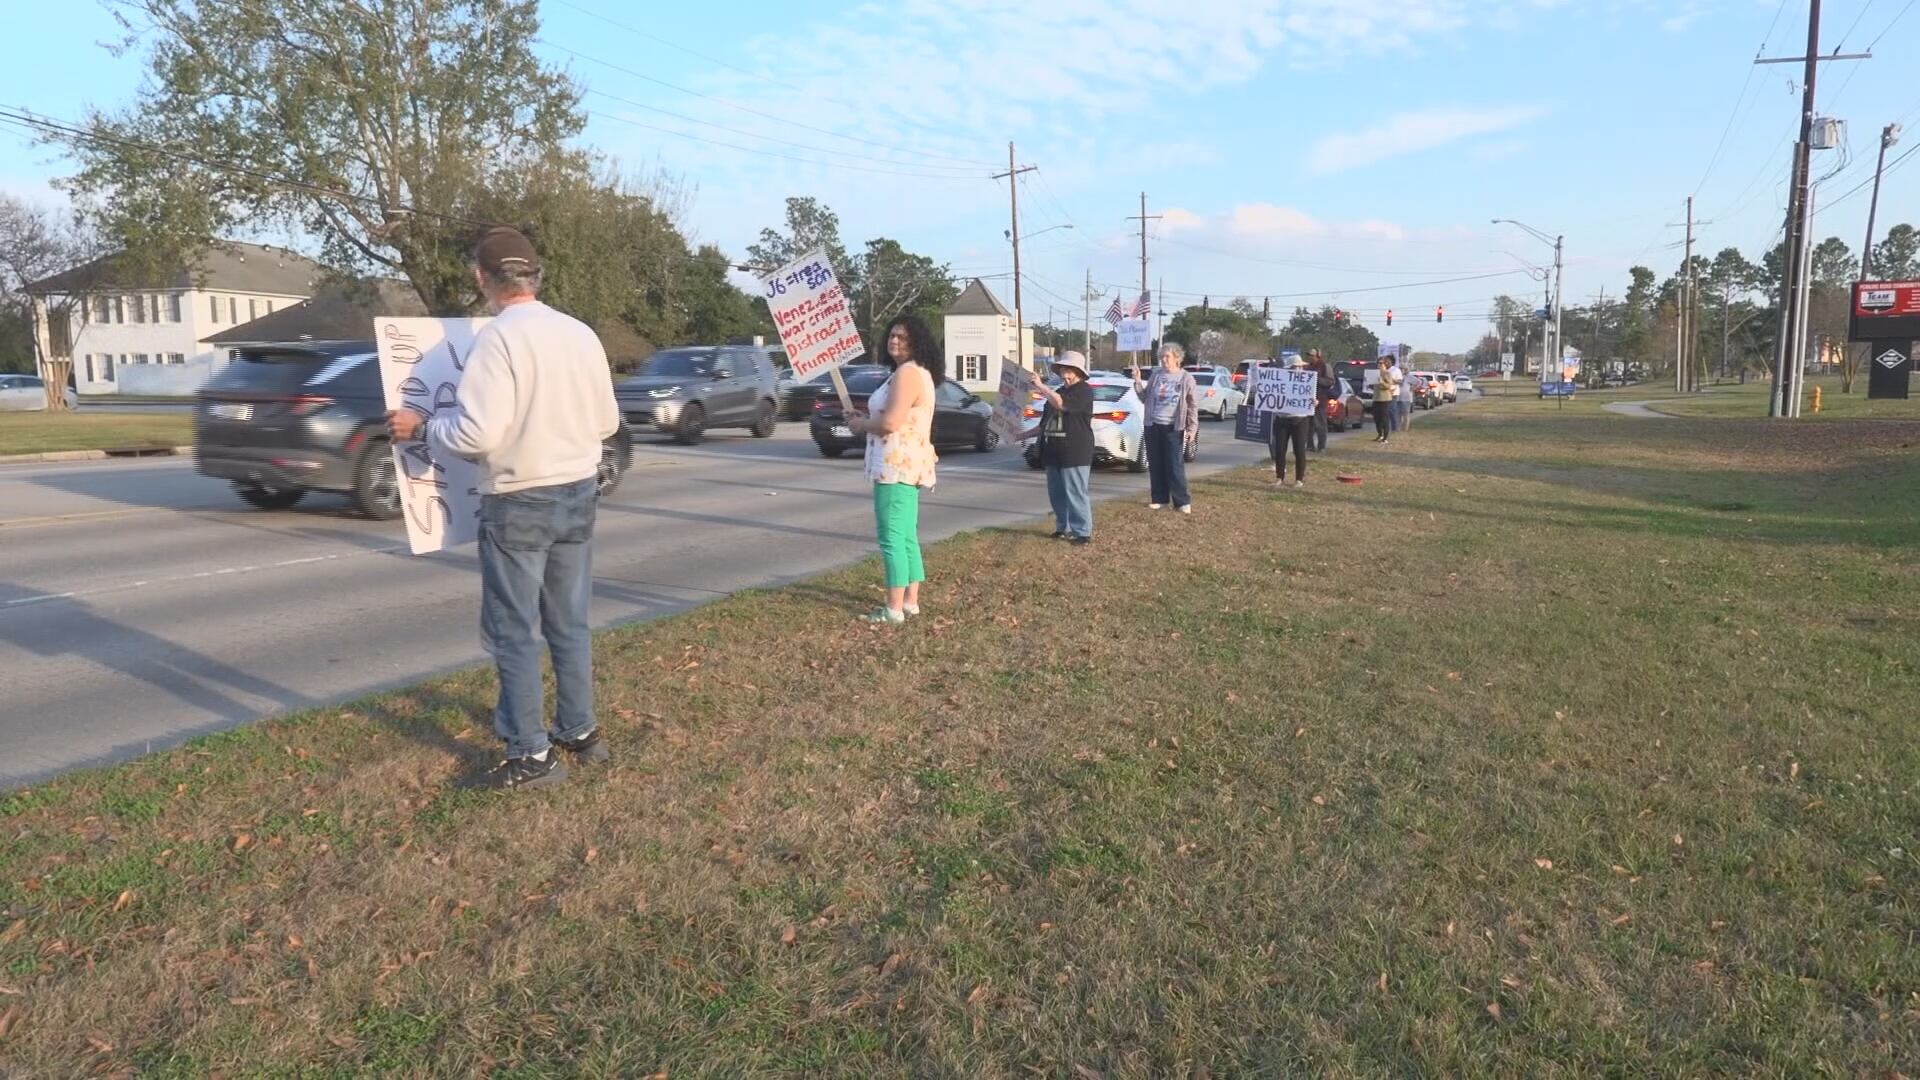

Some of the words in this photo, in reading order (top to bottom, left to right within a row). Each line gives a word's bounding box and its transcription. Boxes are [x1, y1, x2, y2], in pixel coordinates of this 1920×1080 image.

[807, 268, 832, 290] son
[781, 319, 806, 340] war
[809, 299, 845, 326] crimes
[384, 323, 423, 364] UP
[1258, 370, 1281, 381] WILL
[1288, 371, 1314, 383] THEY
[1257, 383, 1286, 394] COME
[1292, 384, 1311, 395] FOR
[1257, 394, 1286, 410] YOU
